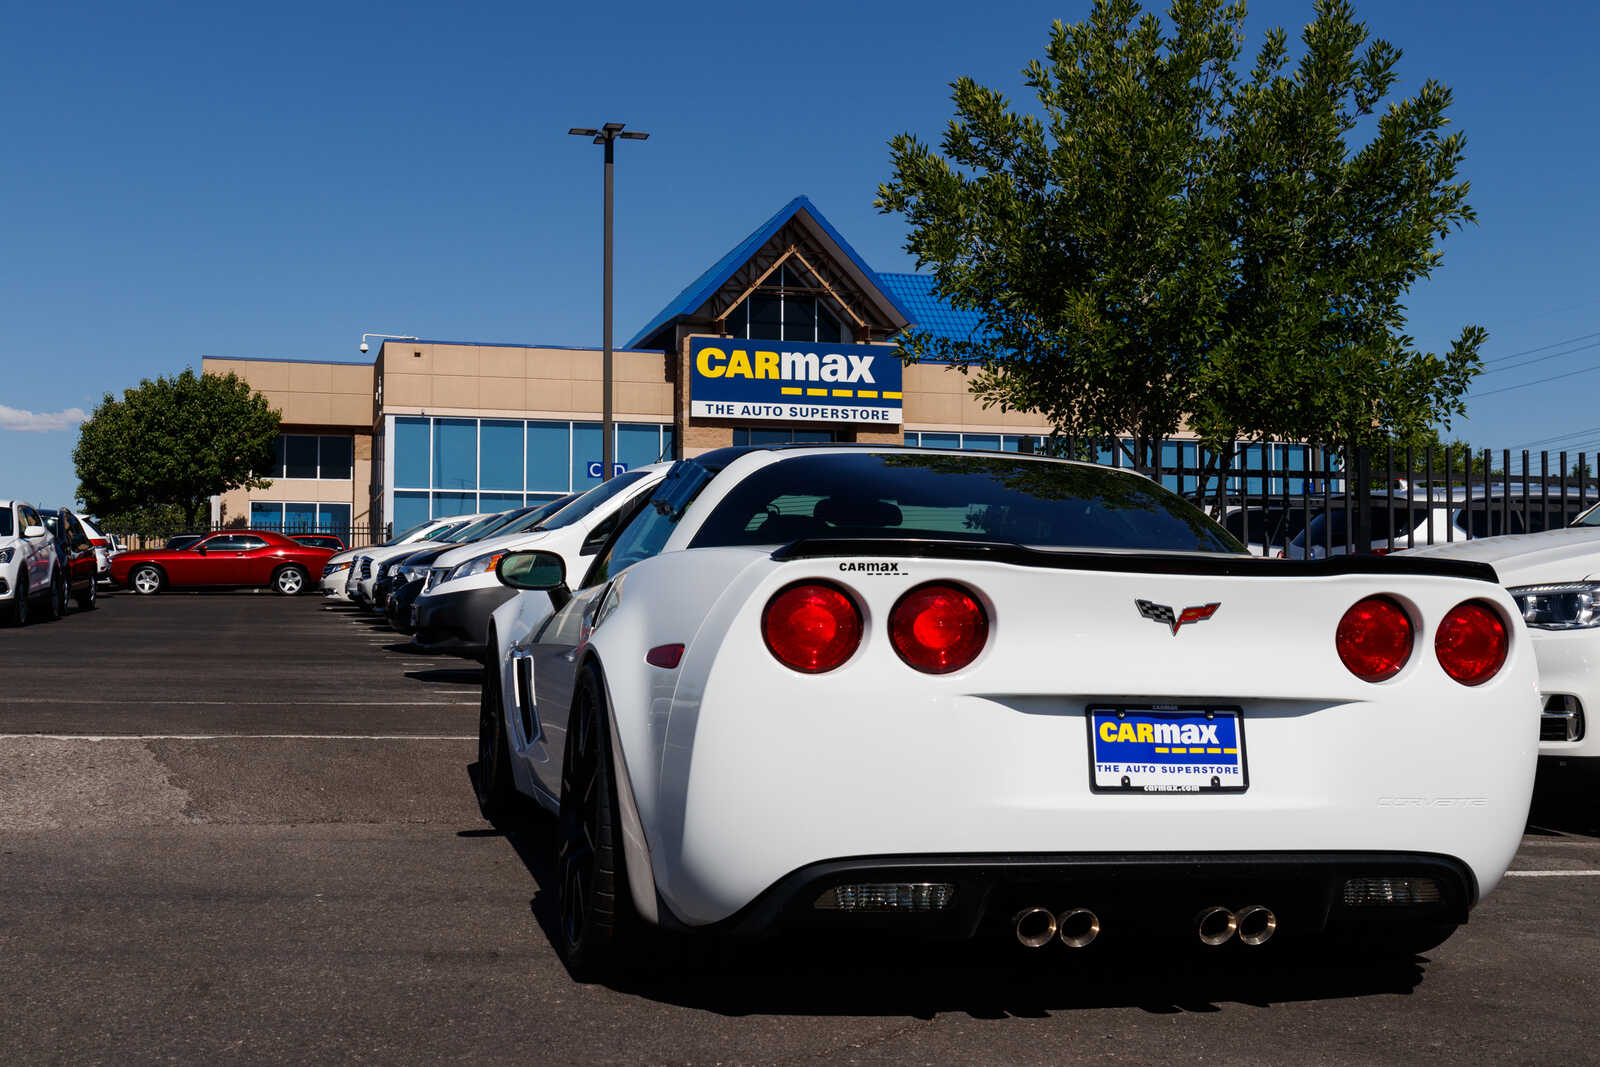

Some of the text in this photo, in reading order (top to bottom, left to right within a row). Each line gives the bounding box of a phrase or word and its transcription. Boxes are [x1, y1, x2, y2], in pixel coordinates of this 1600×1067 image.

[696, 346, 876, 384] CARmax
[705, 403, 890, 422] THE AUTO SUPERSTORE
[589, 463, 602, 477] C
[839, 562, 899, 572] CARmax
[1099, 721, 1220, 745] CARmax
[1097, 764, 1239, 775] THE AUTO SUPERSTORE
[1143, 783, 1200, 793] carmax.com
